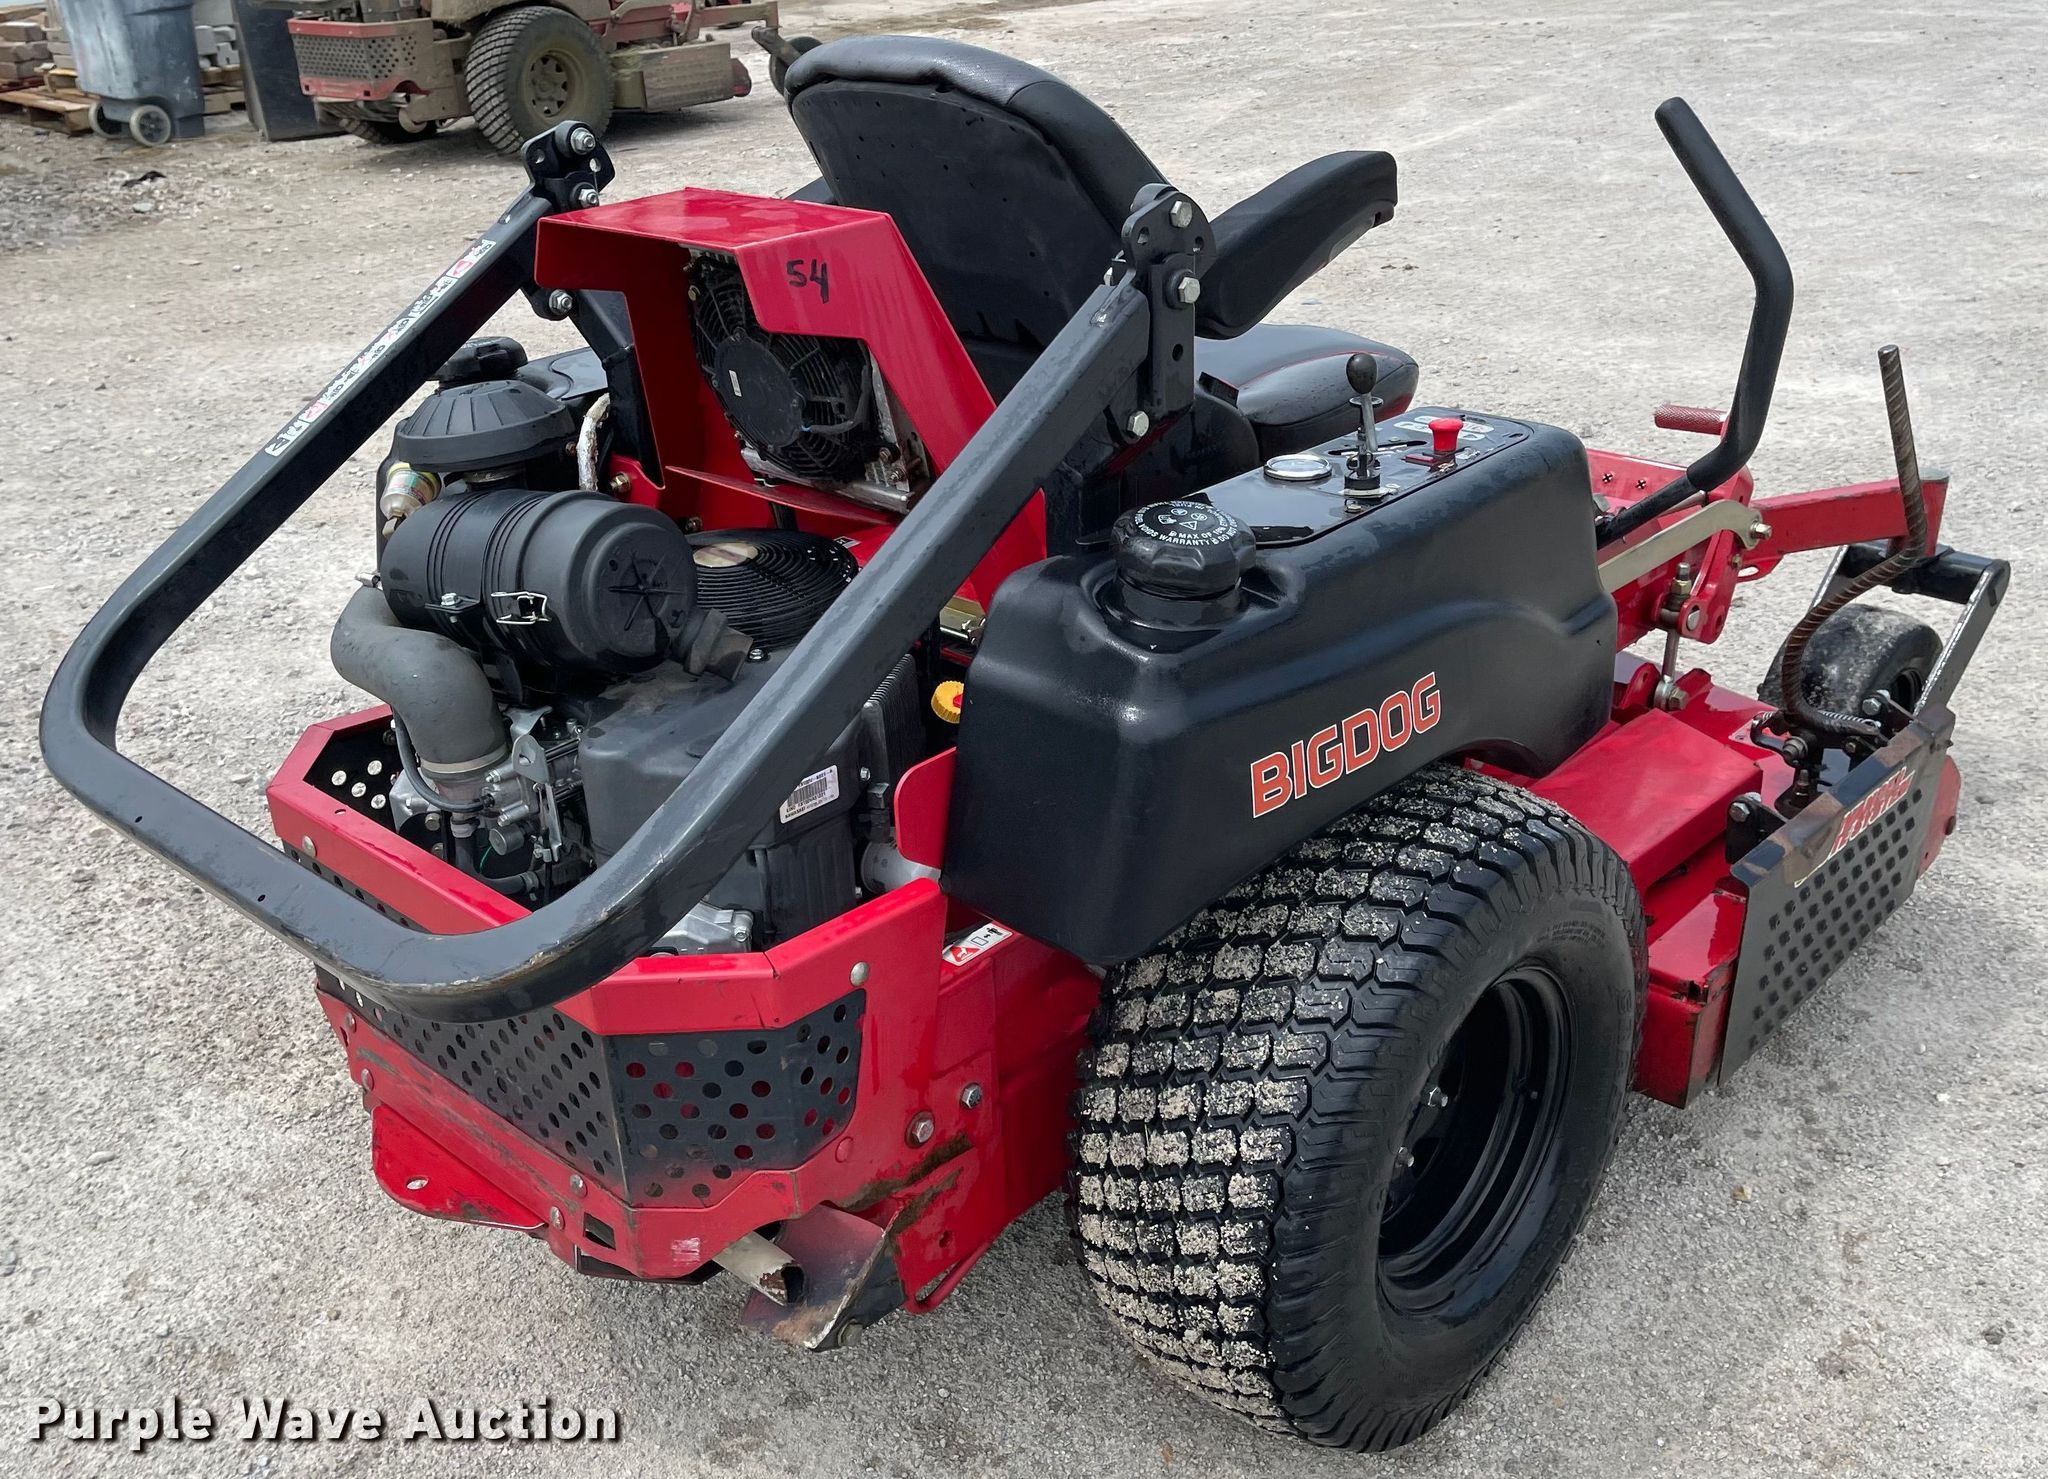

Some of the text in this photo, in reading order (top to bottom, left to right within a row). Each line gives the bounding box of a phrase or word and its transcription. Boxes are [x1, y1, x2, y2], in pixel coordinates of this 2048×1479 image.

[786, 258, 829, 304] 54
[1138, 523, 1159, 537] VOIDS
[1159, 534, 1210, 546] WARRANTY
[1178, 532, 1200, 540] MAX
[1201, 531, 1213, 539] OF
[1217, 533, 1230, 542] DO
[1250, 671, 1441, 819] BIGDOG
